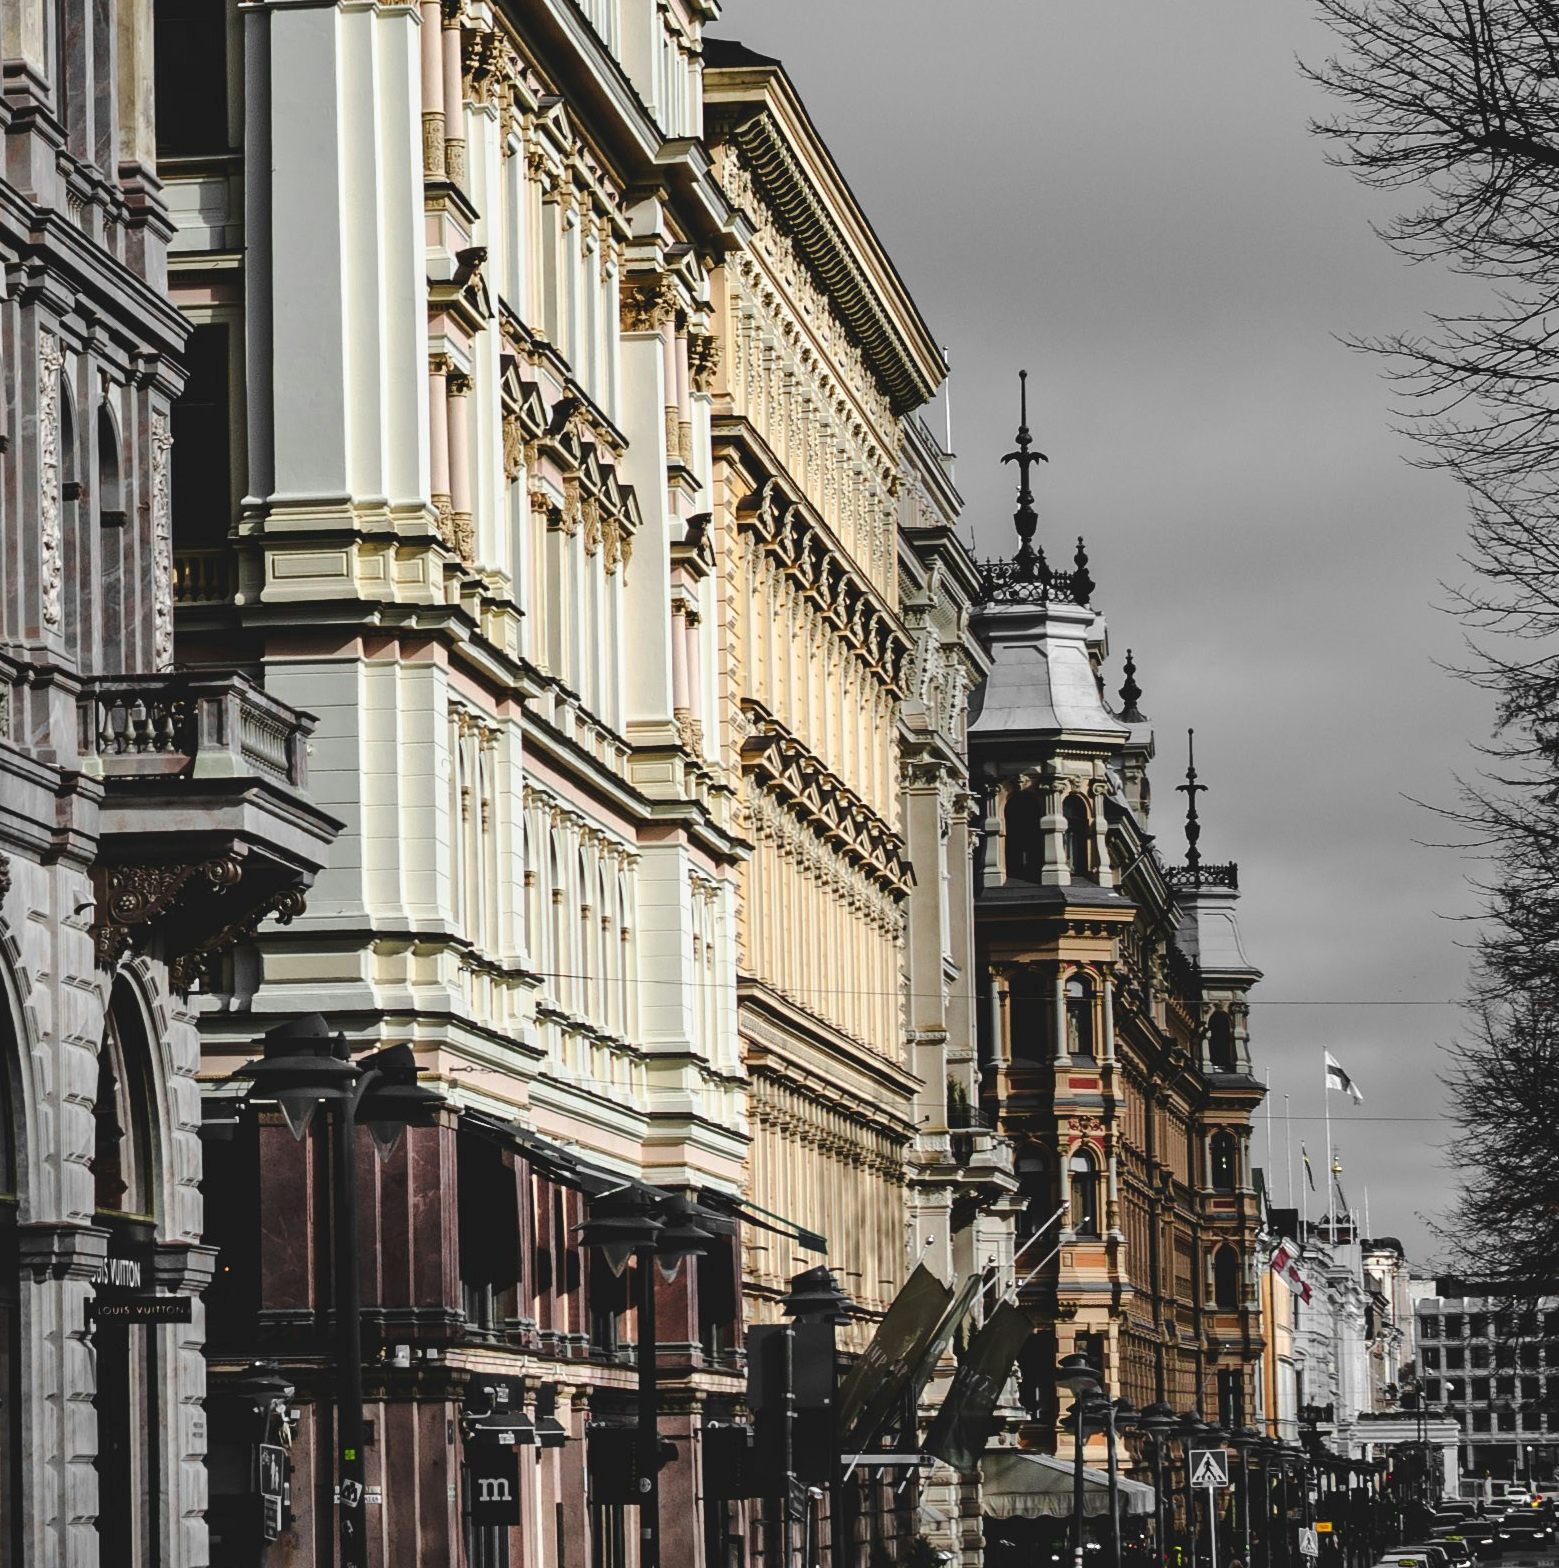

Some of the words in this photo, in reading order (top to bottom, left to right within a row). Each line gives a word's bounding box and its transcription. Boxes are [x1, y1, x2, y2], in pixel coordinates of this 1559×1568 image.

[109, 1257, 141, 1288] VUITTON
[97, 1306, 131, 1316] LOUIS
[136, 1305, 184, 1316] VUITTON
[477, 1477, 513, 1502] m
